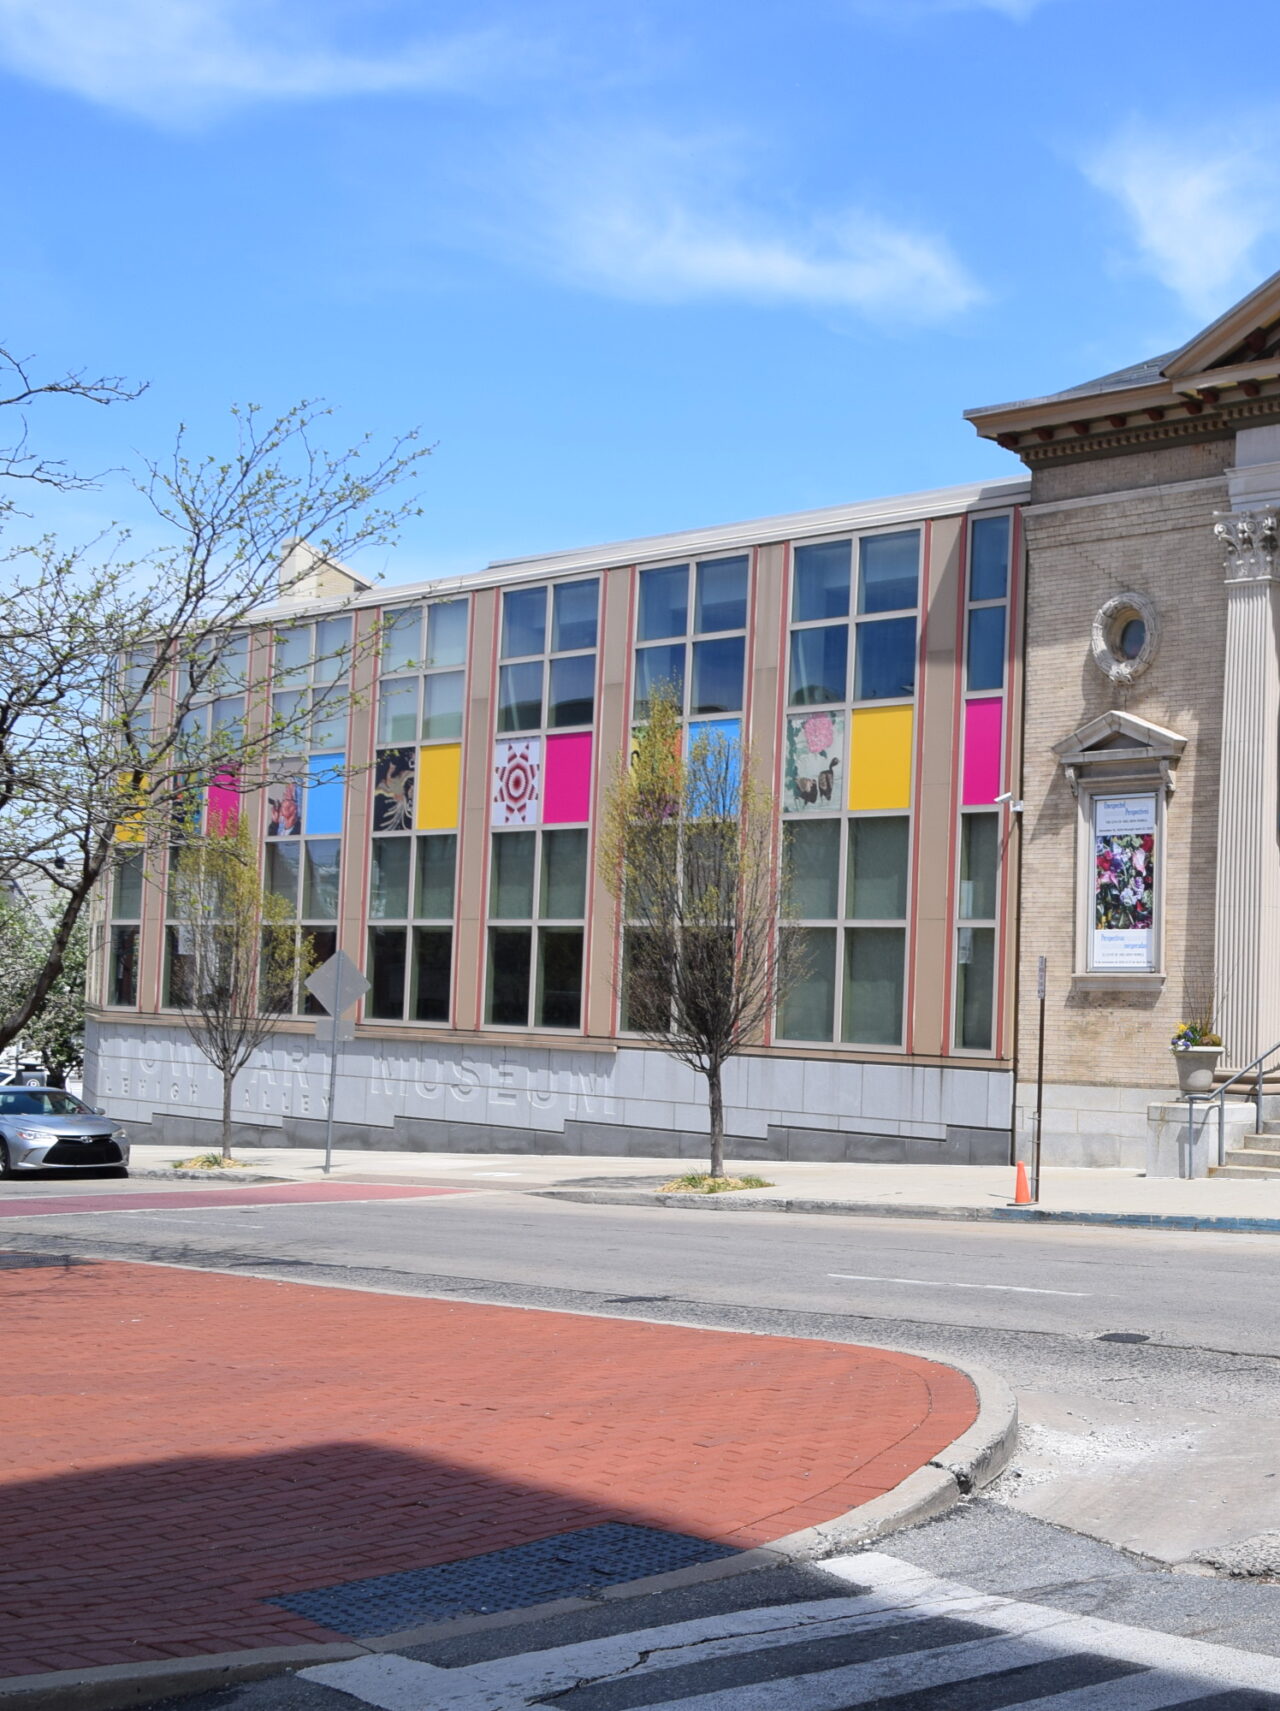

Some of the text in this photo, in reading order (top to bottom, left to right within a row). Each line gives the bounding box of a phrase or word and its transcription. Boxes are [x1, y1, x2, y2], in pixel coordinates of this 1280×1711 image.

[105, 1075, 332, 1114] LEHIGH ALLEY
[369, 1050, 617, 1115] MUSEUM
